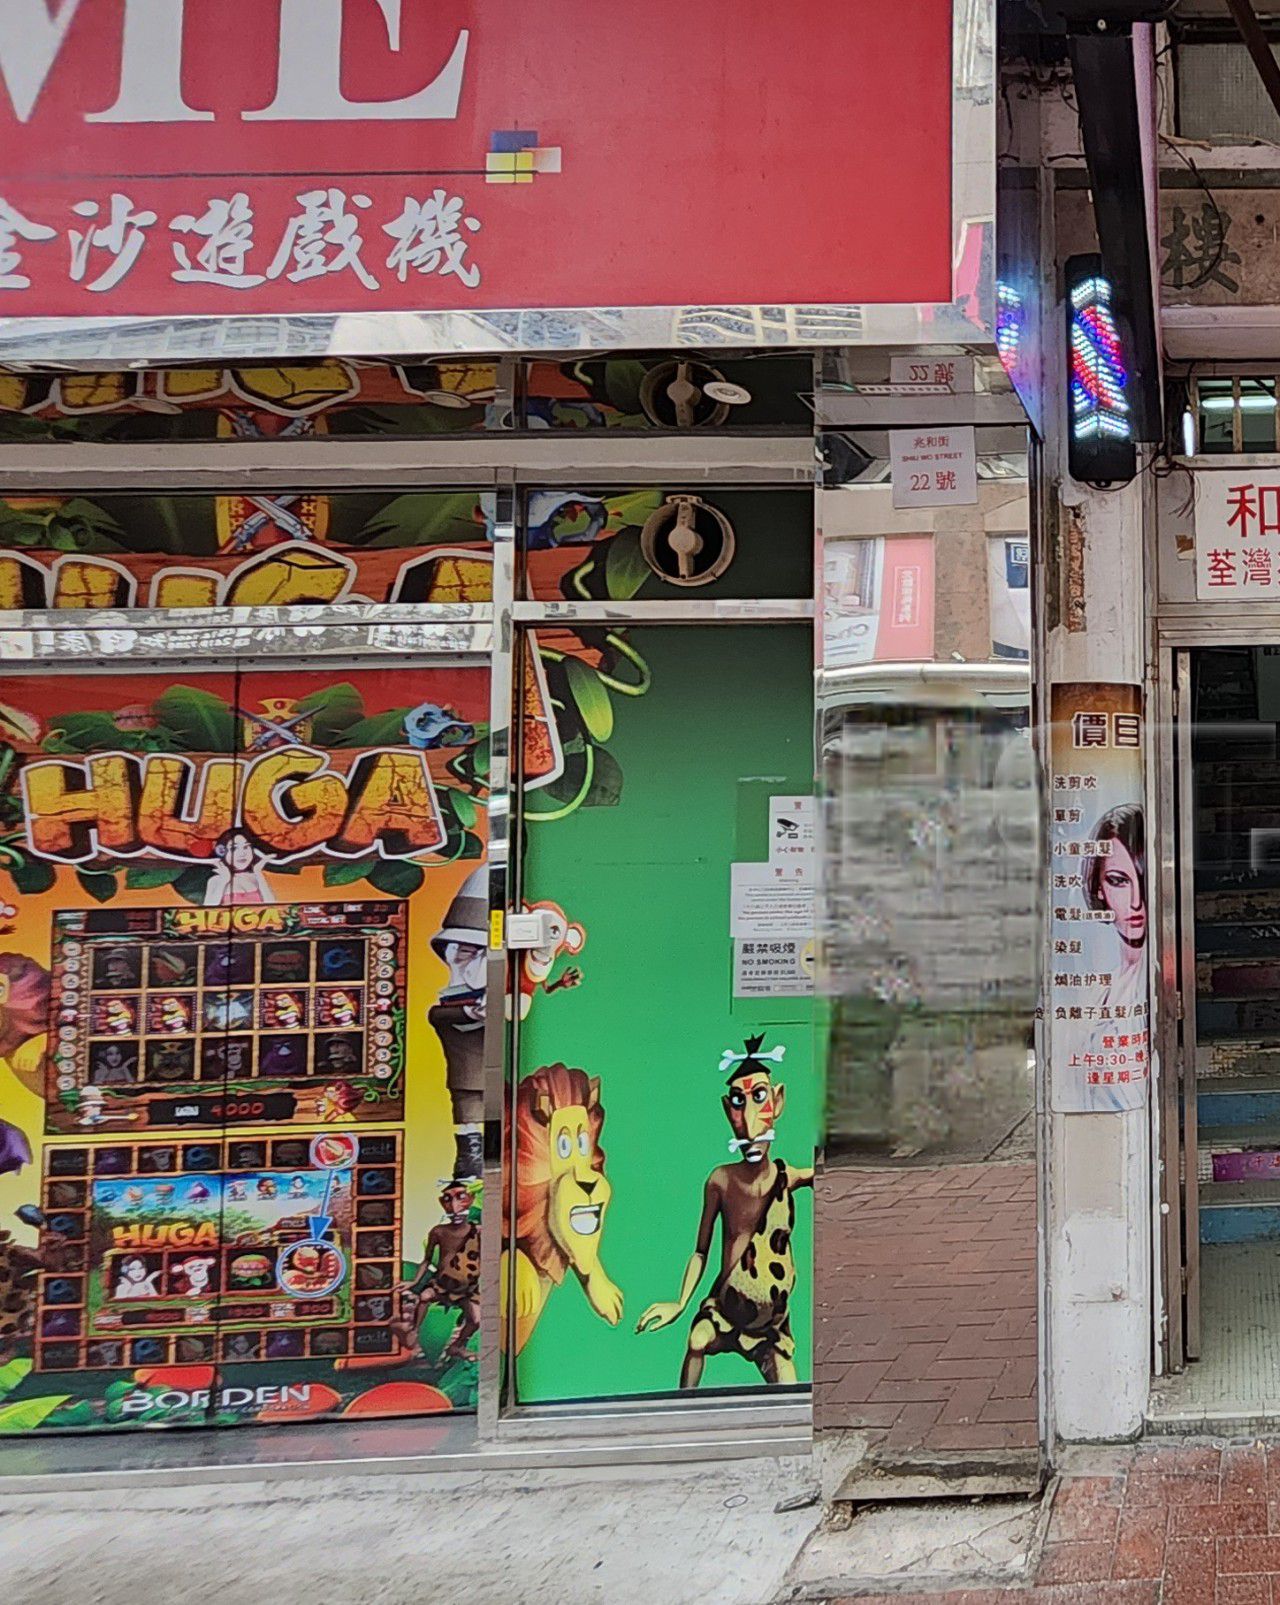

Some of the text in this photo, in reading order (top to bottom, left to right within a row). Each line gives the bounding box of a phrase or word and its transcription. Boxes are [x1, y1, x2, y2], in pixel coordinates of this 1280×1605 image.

[910, 470, 956, 491] 22 號
[1054, 776, 1097, 790] 洗剪吹
[21, 748, 448, 863] HUGA
[1054, 876, 1082, 888] 洗吹
[742, 942, 796, 954] 嚴禁吸煙
[742, 958, 754, 966] NO
[112, 1221, 218, 1248] HUGA
